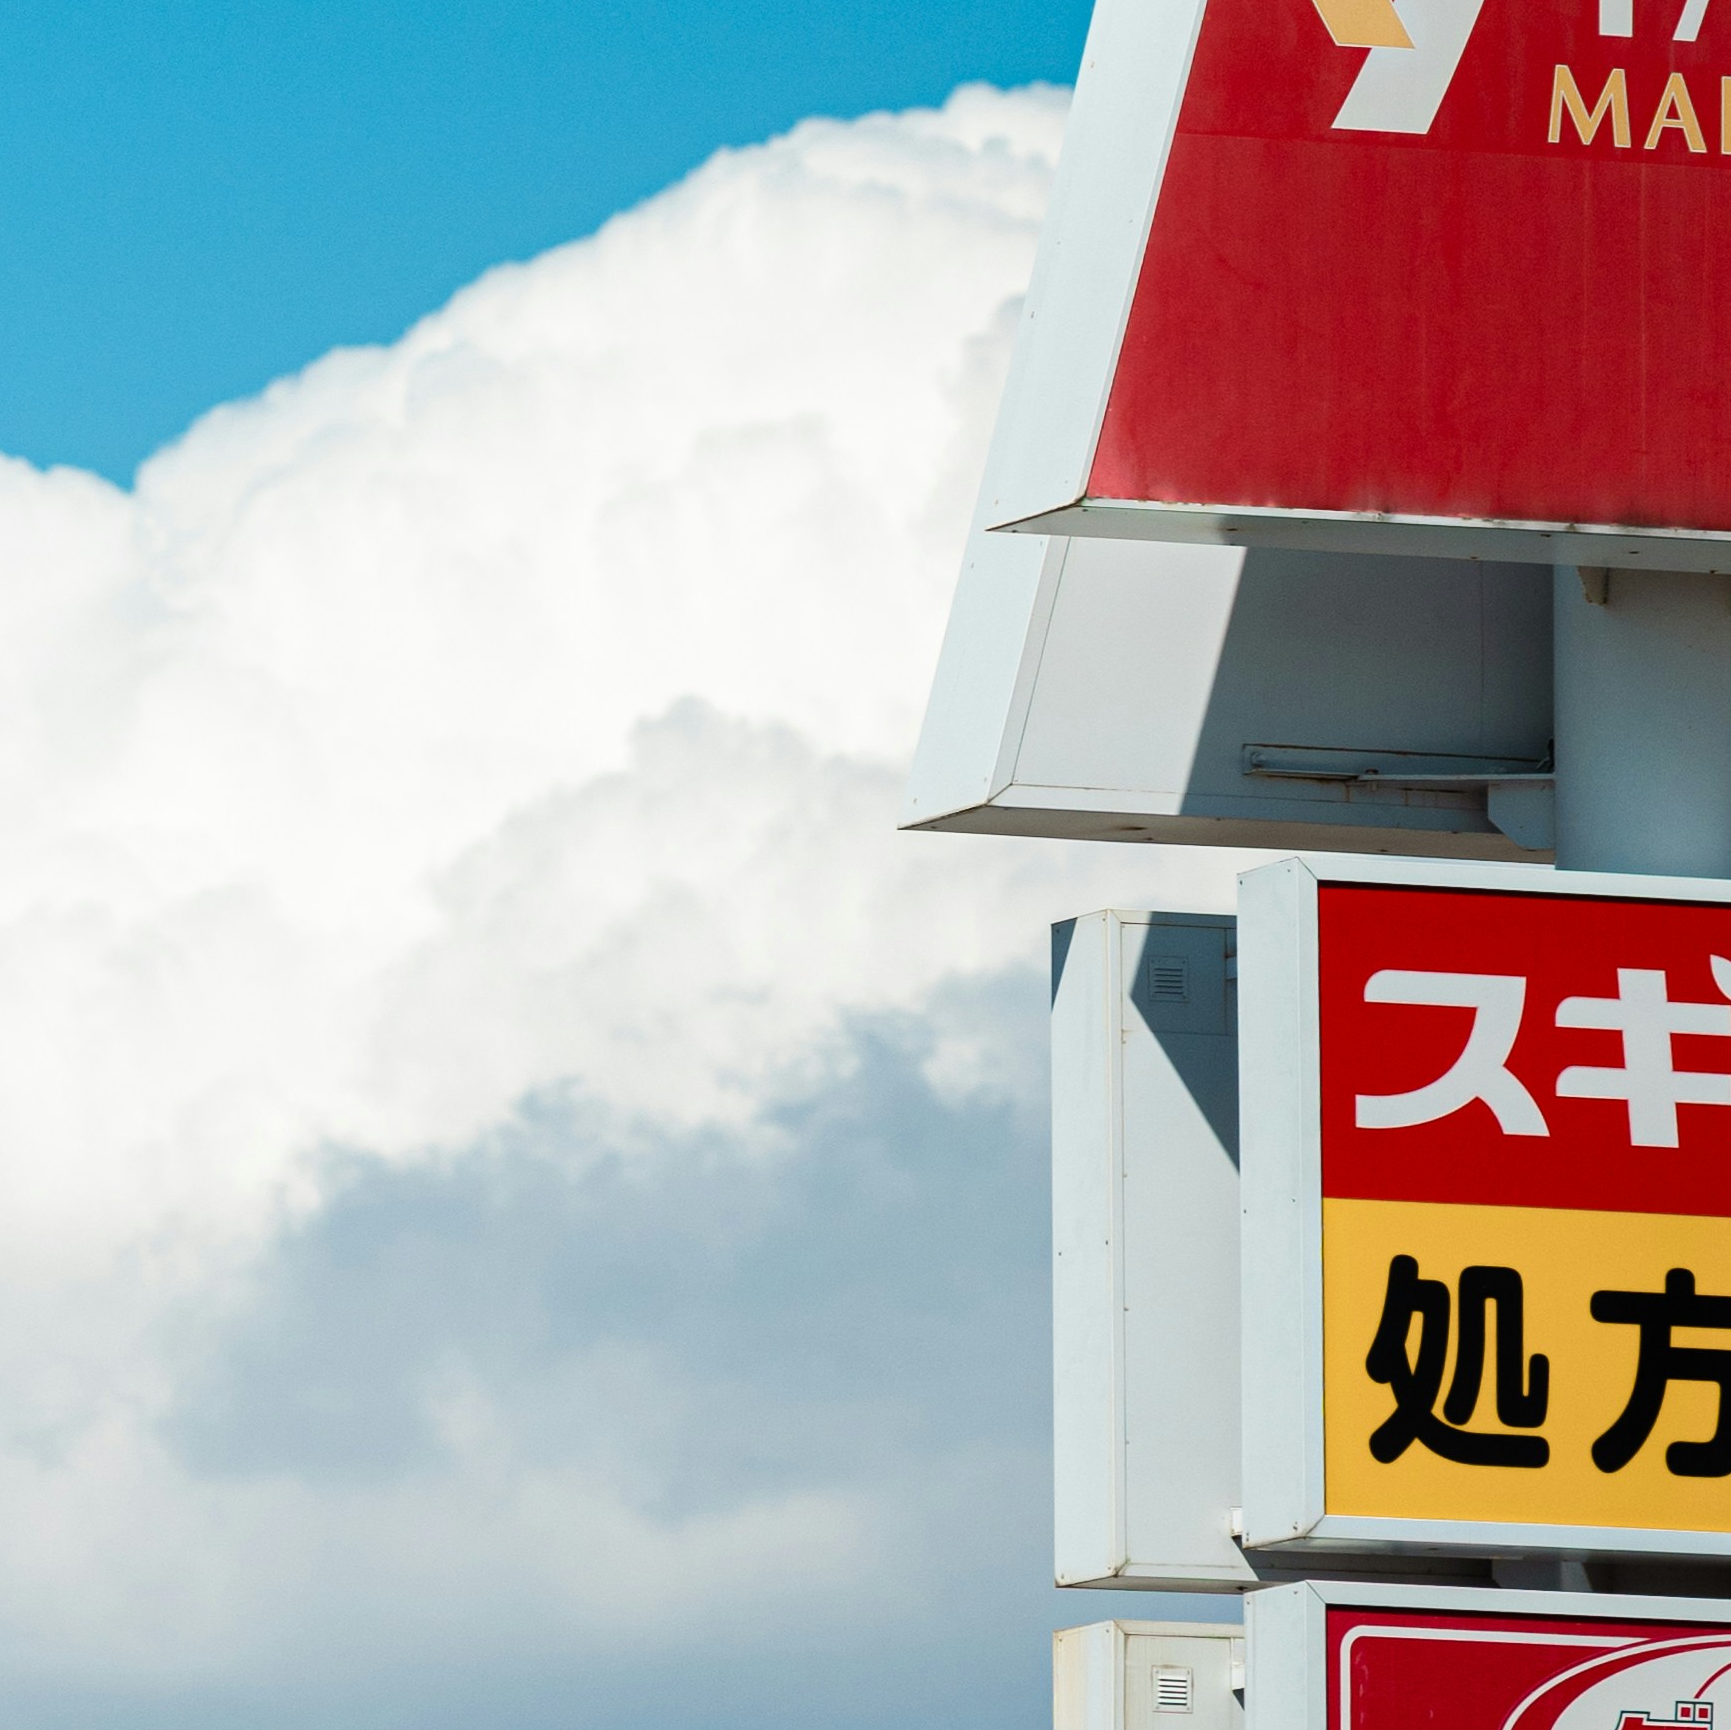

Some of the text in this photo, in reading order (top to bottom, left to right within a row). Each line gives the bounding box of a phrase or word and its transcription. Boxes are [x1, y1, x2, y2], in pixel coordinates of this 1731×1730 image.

[1547, 64, 1731, 155] MA
[1355, 954, 1731, 1148] スギ
[1366, 1254, 1731, 1478] 処方
